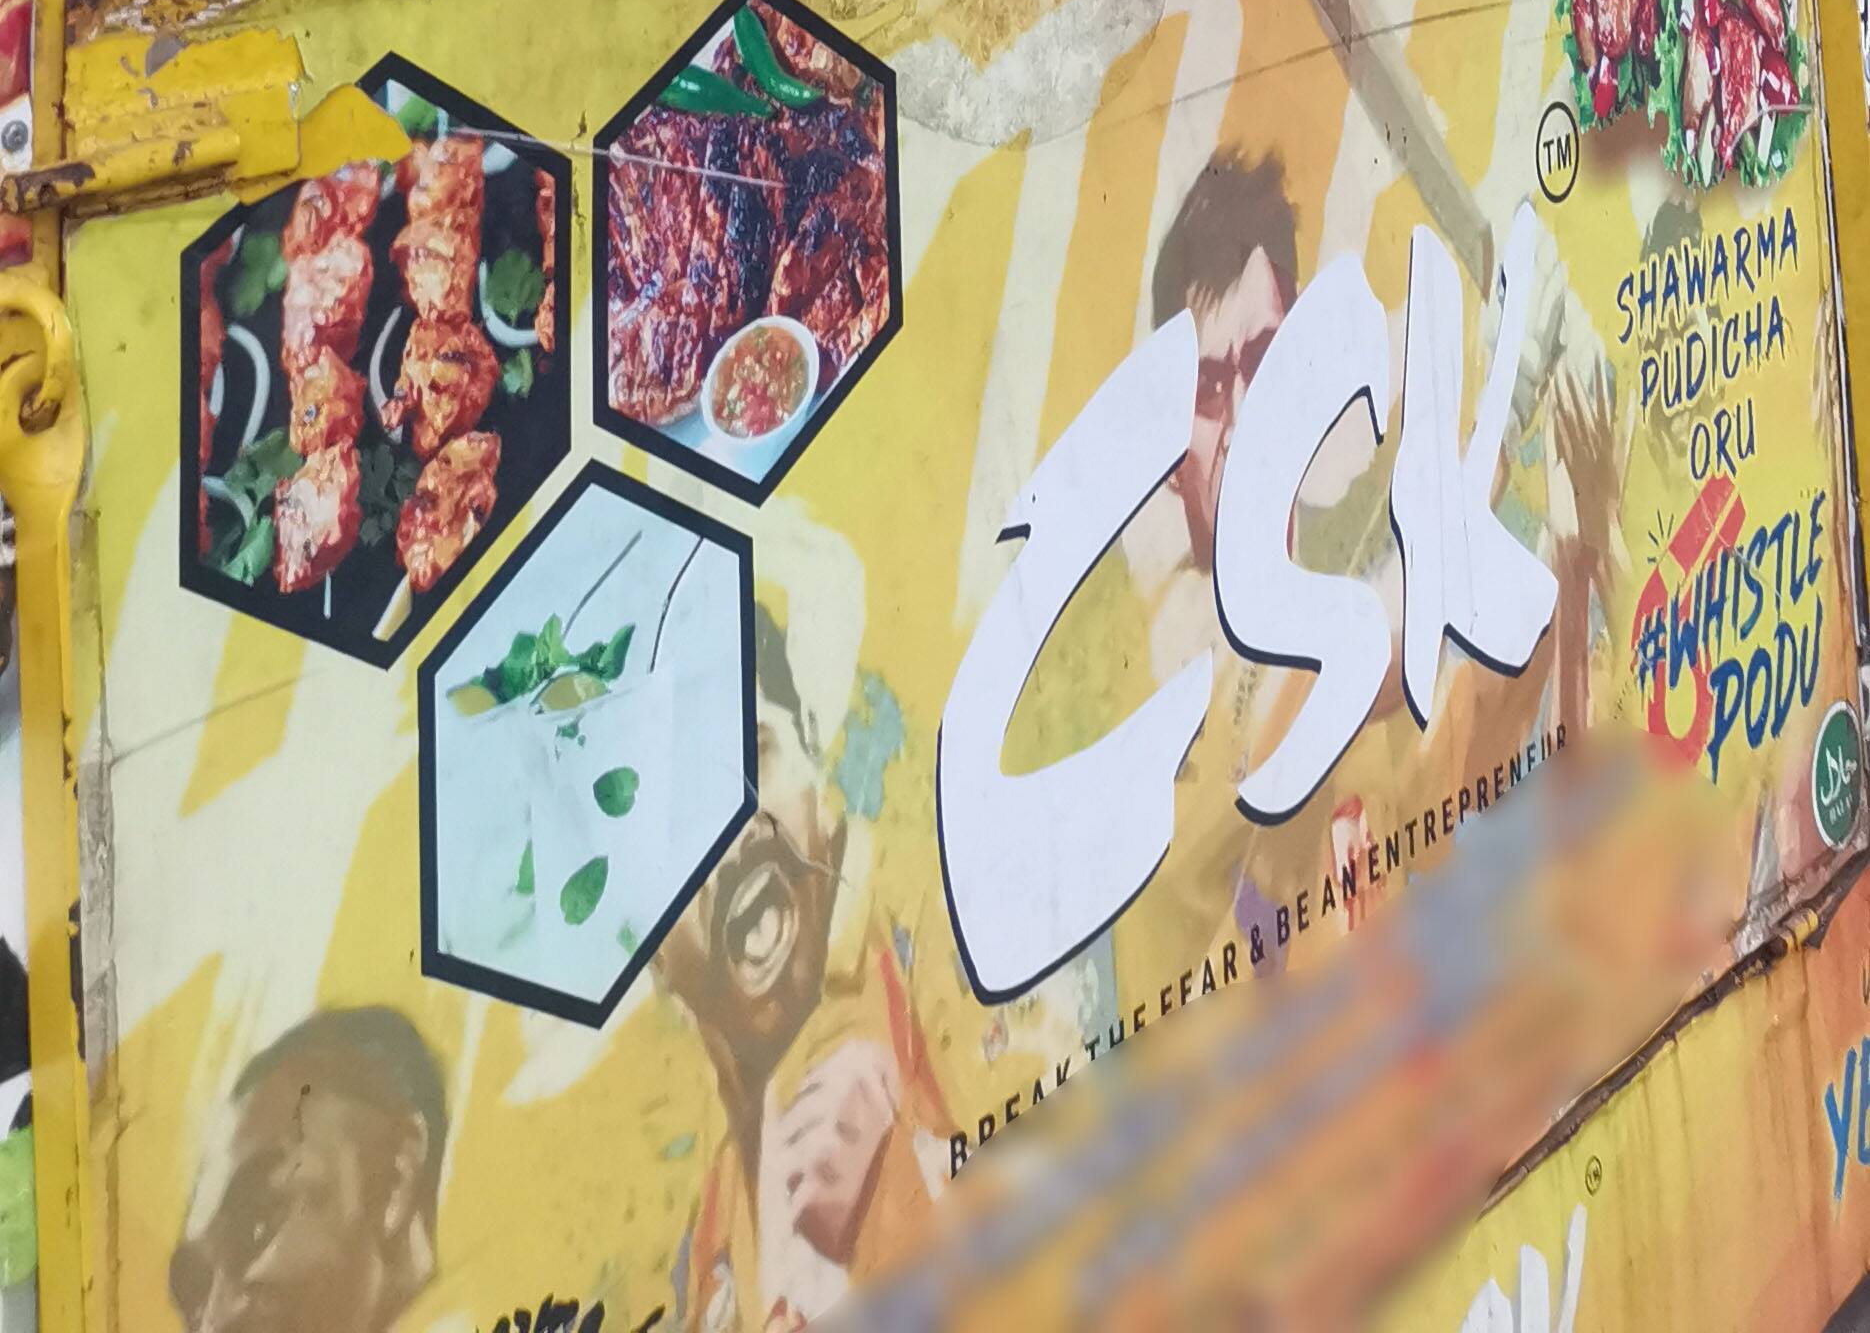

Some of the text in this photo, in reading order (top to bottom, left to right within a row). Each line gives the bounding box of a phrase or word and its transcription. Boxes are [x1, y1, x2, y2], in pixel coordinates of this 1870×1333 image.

[1543, 137, 1573, 175] TM
[1616, 206, 1799, 344] SHAWARMA
[1640, 295, 1785, 421] PUDICHA
[1690, 398, 1756, 480] ORU
[936, 197, 1560, 1005] CSK
[1637, 489, 1826, 695] #WHISTLE
[1706, 590, 1824, 785] PODU
[1250, 924, 1265, 964] &
[1275, 890, 1311, 949] BE
[1321, 857, 1357, 917] AN
